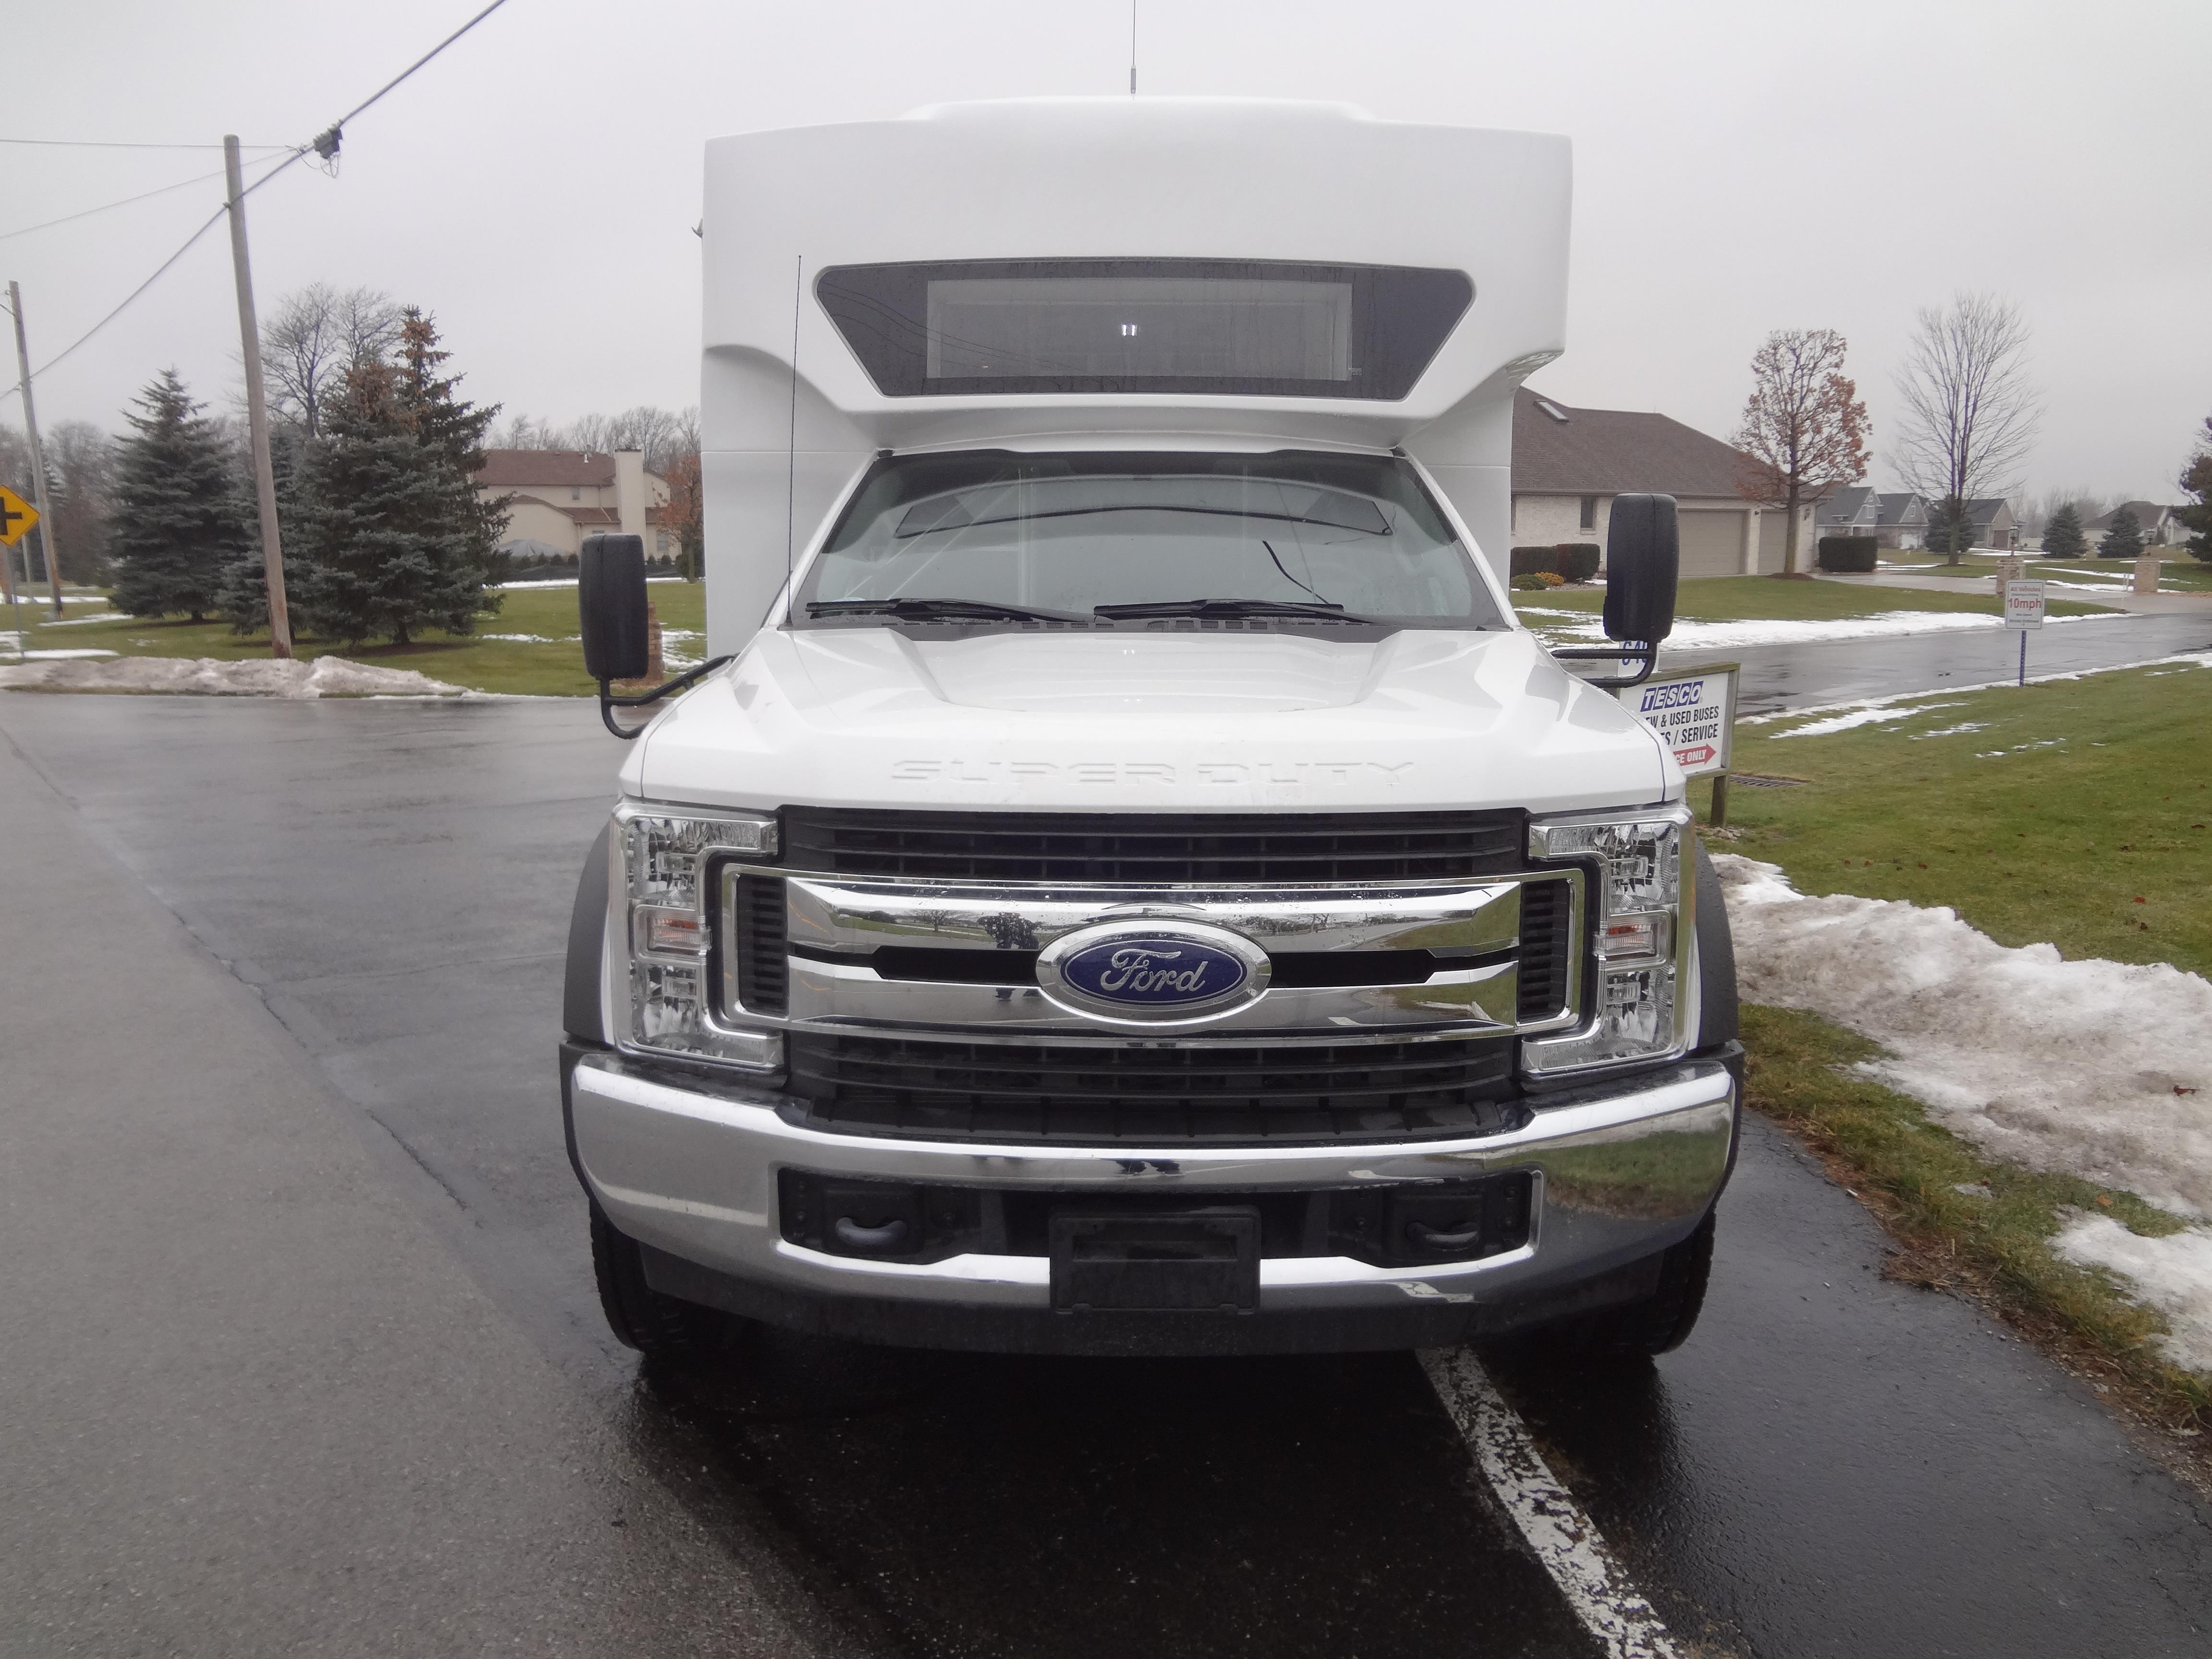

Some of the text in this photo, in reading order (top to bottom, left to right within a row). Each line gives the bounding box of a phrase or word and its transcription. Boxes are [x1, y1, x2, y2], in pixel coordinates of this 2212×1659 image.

[2008, 598, 2042, 611] 10mph
[1643, 684, 1702, 709] TESCO
[1660, 714, 1667, 727] &
[1670, 710, 1691, 726] USED
[1693, 705, 1719, 722] BUSES
[1681, 723, 1719, 744] SERVICE
[1686, 749, 1707, 762] ONLY
[891, 760, 1414, 786] SUPER DUTY
[1100, 948, 1209, 992] Ford
